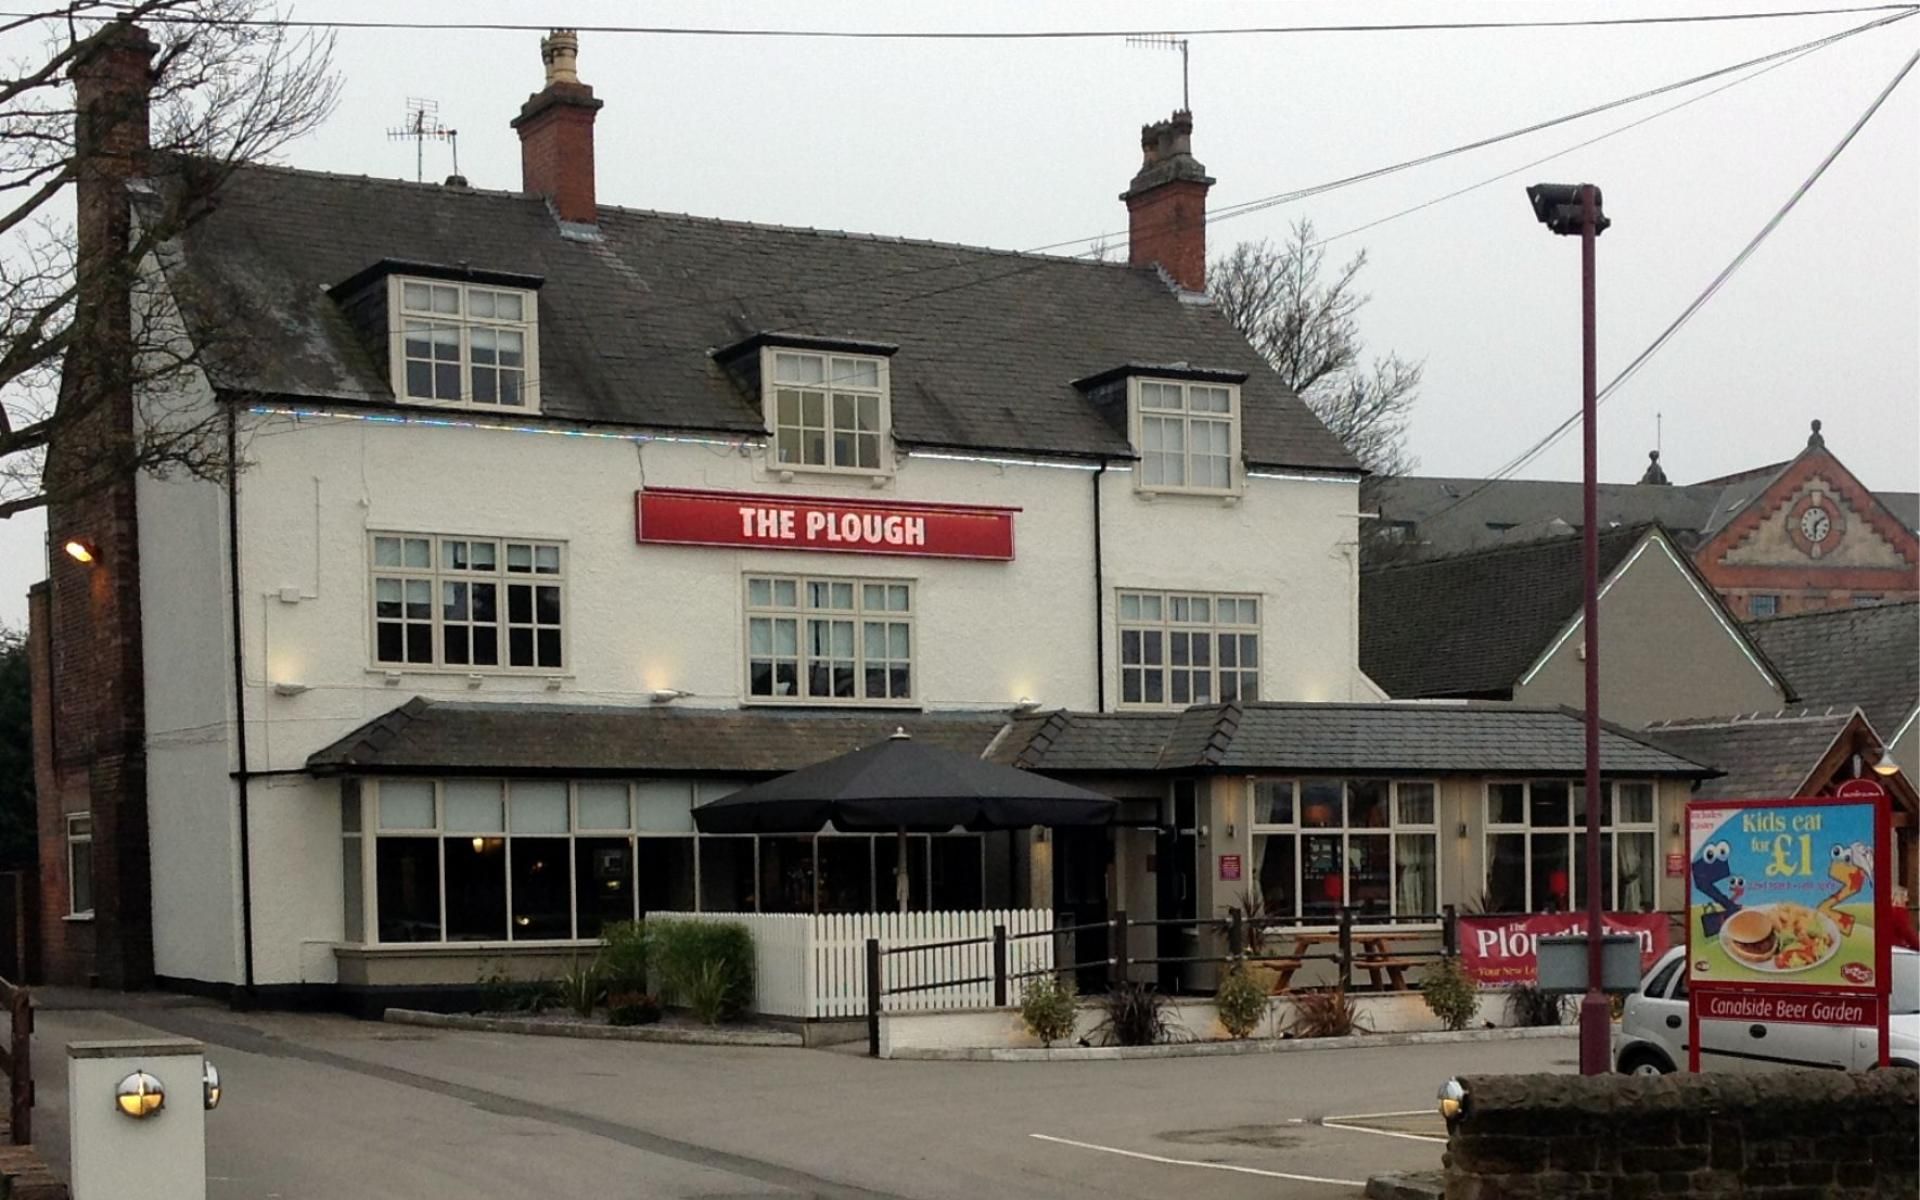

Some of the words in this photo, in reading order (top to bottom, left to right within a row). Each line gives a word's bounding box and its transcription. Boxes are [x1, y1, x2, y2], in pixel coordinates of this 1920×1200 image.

[739, 507, 796, 540] THE
[806, 511, 926, 546] PLOUGH
[1742, 811, 1787, 833] Kids
[1792, 812, 1823, 832] eat
[1751, 837, 1770, 852] for
[1765, 833, 1814, 877] £1
[1477, 924, 1589, 958] Plou
[1710, 997, 1773, 1017] Canalside
[1776, 1000, 1808, 1018] Beer
[1812, 1001, 1863, 1021] Garden
